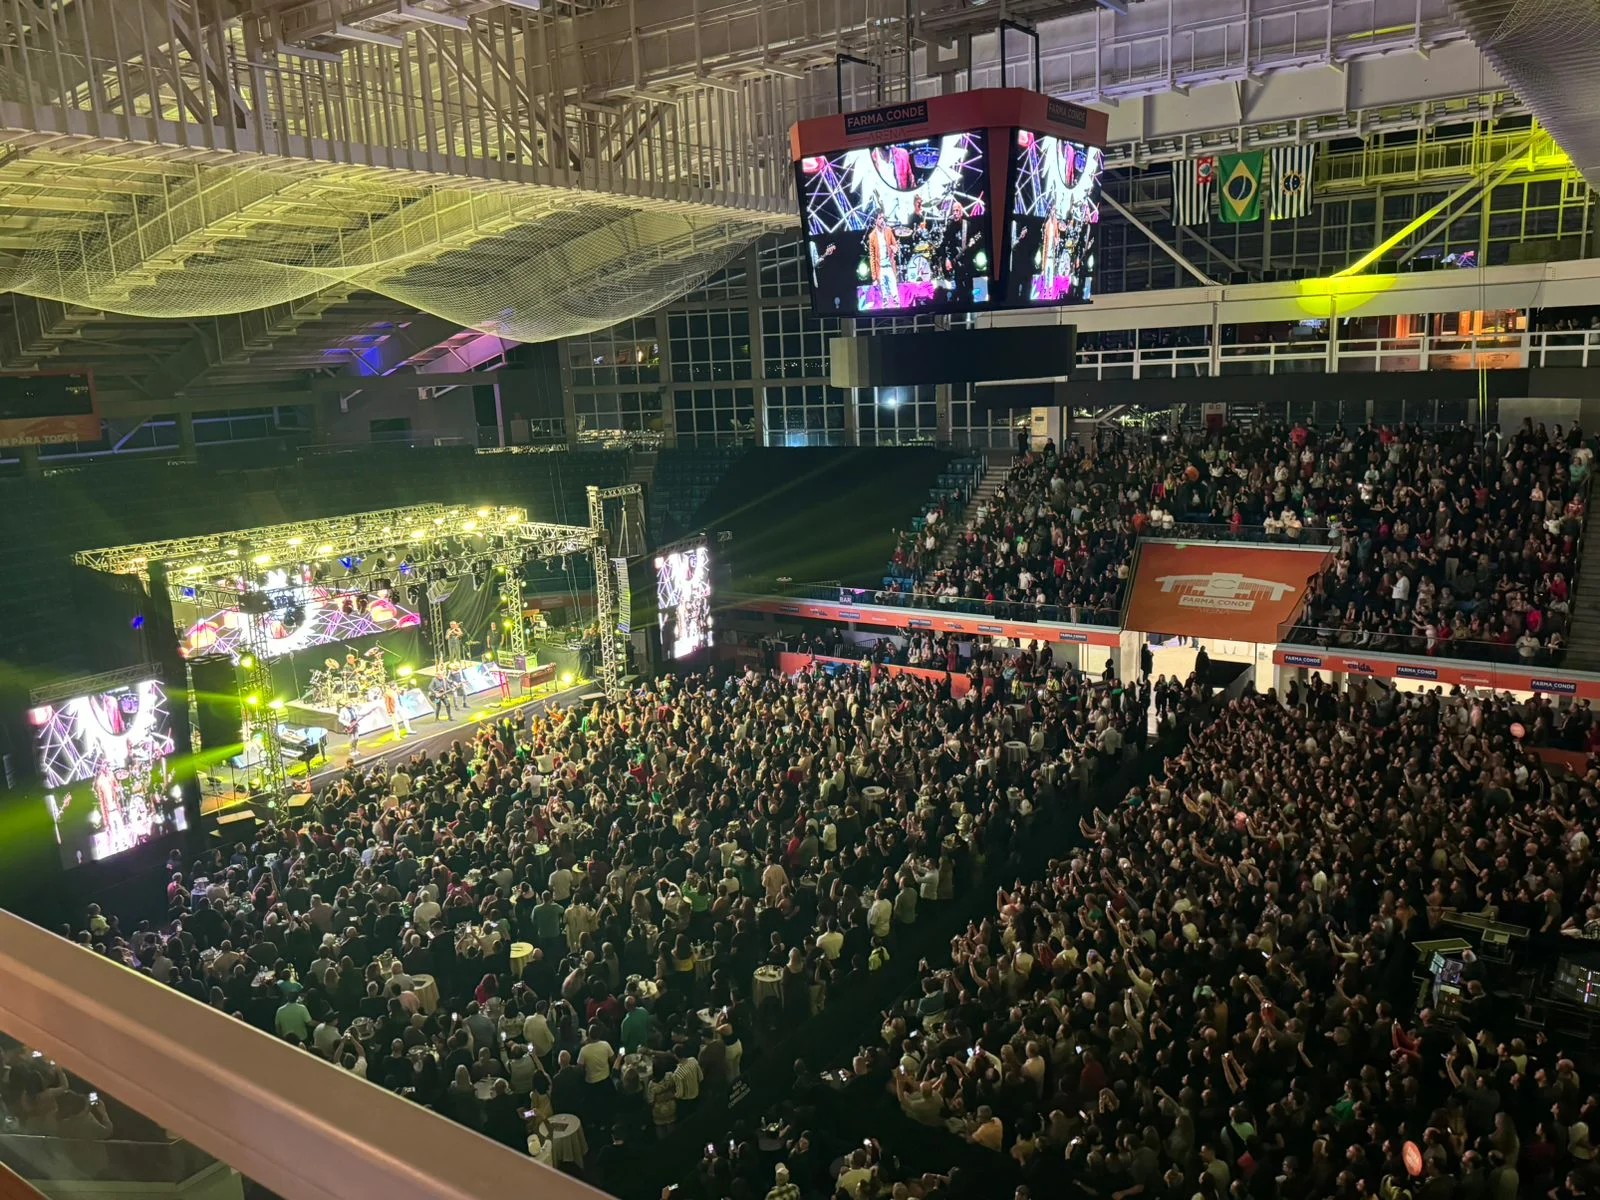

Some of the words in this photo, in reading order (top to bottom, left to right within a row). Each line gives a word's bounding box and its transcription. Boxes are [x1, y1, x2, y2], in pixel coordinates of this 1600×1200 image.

[847, 113, 883, 127] FARMA
[886, 105, 925, 121] CONDE
[1048, 103, 1067, 117] FARMA
[1067, 108, 1085, 122] CONDE
[1182, 596, 1214, 605] FARMA
[1217, 599, 1252, 608] CONDE
